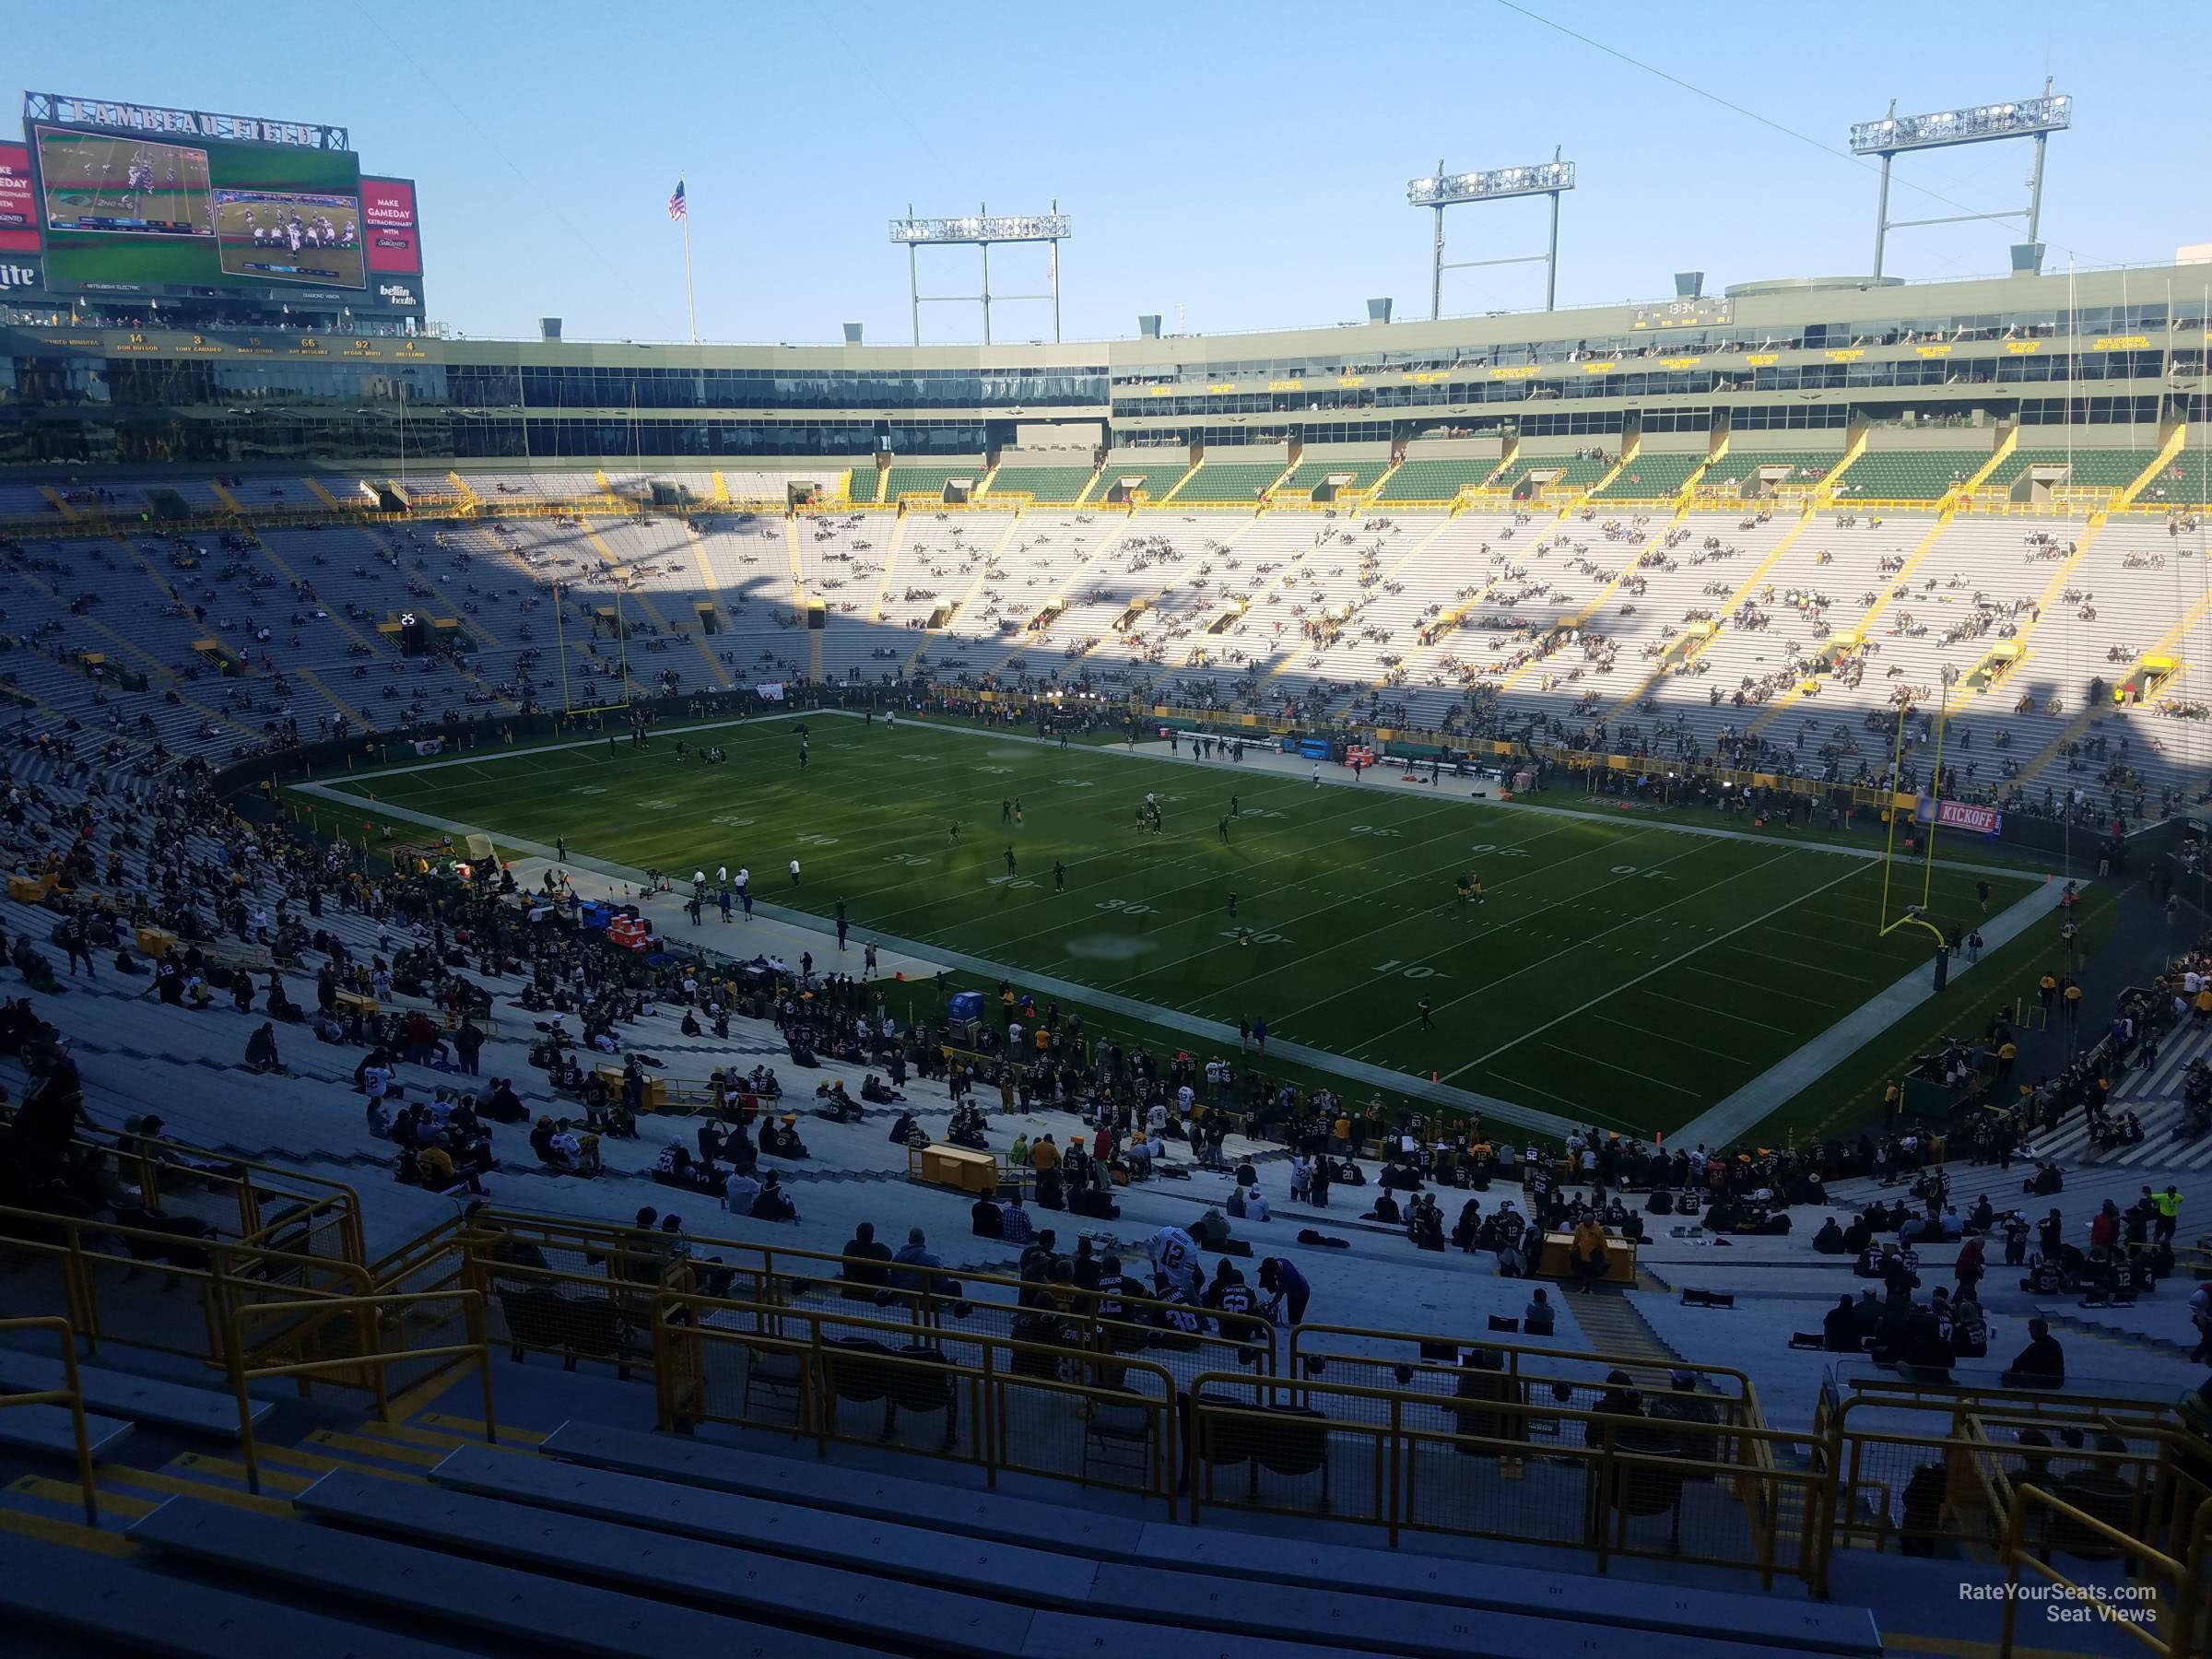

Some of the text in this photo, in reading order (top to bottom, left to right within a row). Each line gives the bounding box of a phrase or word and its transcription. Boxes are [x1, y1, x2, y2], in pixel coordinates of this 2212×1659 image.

[74, 100, 314, 145] LAMBEAU FIELD
[368, 208, 410, 218] GAMEDAY
[367, 218, 413, 227] EXTRAORDINARY
[380, 284, 410, 297] bellin
[392, 296, 417, 305] health
[1669, 302, 1695, 314] 13:34
[1722, 304, 1727, 313] 0
[129, 334, 144, 343] 14
[194, 335, 202, 345] 3
[250, 337, 260, 346] 15
[301, 338, 315, 347] 66
[355, 340, 369, 348] 92
[406, 341, 414, 350] 4
[401, 613, 415, 625] 25
[1943, 806, 1994, 827] KICKOFF
[1348, 825, 1400, 837] 30
[1470, 844, 1528, 858] 20
[1609, 865, 1666, 878] 10
[1094, 899, 1150, 915] 30
[1219, 926, 1282, 945] 20
[1371, 959, 1435, 980] 10
[366, 1076, 379, 1088] 12
[564, 1072, 575, 1085] 12
[1411, 1118, 1421, 1127] 63
[1526, 1150, 1537, 1160] 52
[1067, 1159, 1079, 1171] 12
[1420, 1156, 1430, 1166] 12
[1342, 1169, 1354, 1180] 20
[1535, 1180, 1547, 1191] 52
[1508, 1226, 1518, 1237] 12
[1161, 1240, 1185, 1269] 12
[1223, 1294, 1249, 1312] 52
